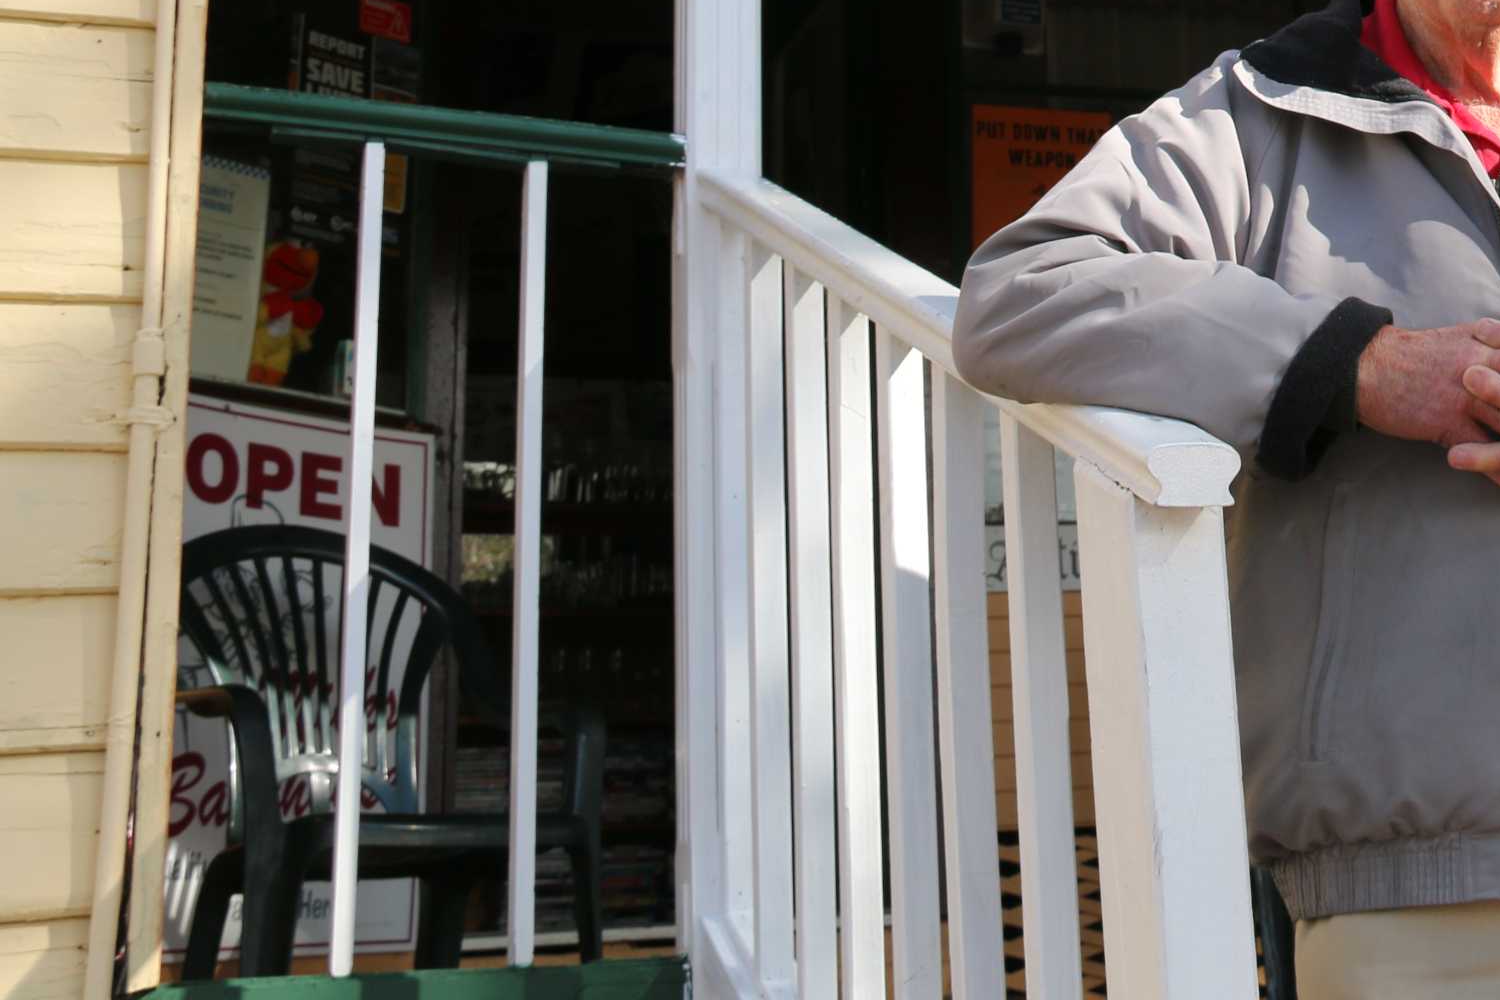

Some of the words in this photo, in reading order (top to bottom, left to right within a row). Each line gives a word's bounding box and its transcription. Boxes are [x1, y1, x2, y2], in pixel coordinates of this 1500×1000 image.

[308, 31, 365, 60] REPORT
[305, 57, 365, 94] SAVE
[976, 120, 1006, 139] PUT
[1013, 122, 1060, 142] DOWN
[185, 432, 401, 527] OPEN
